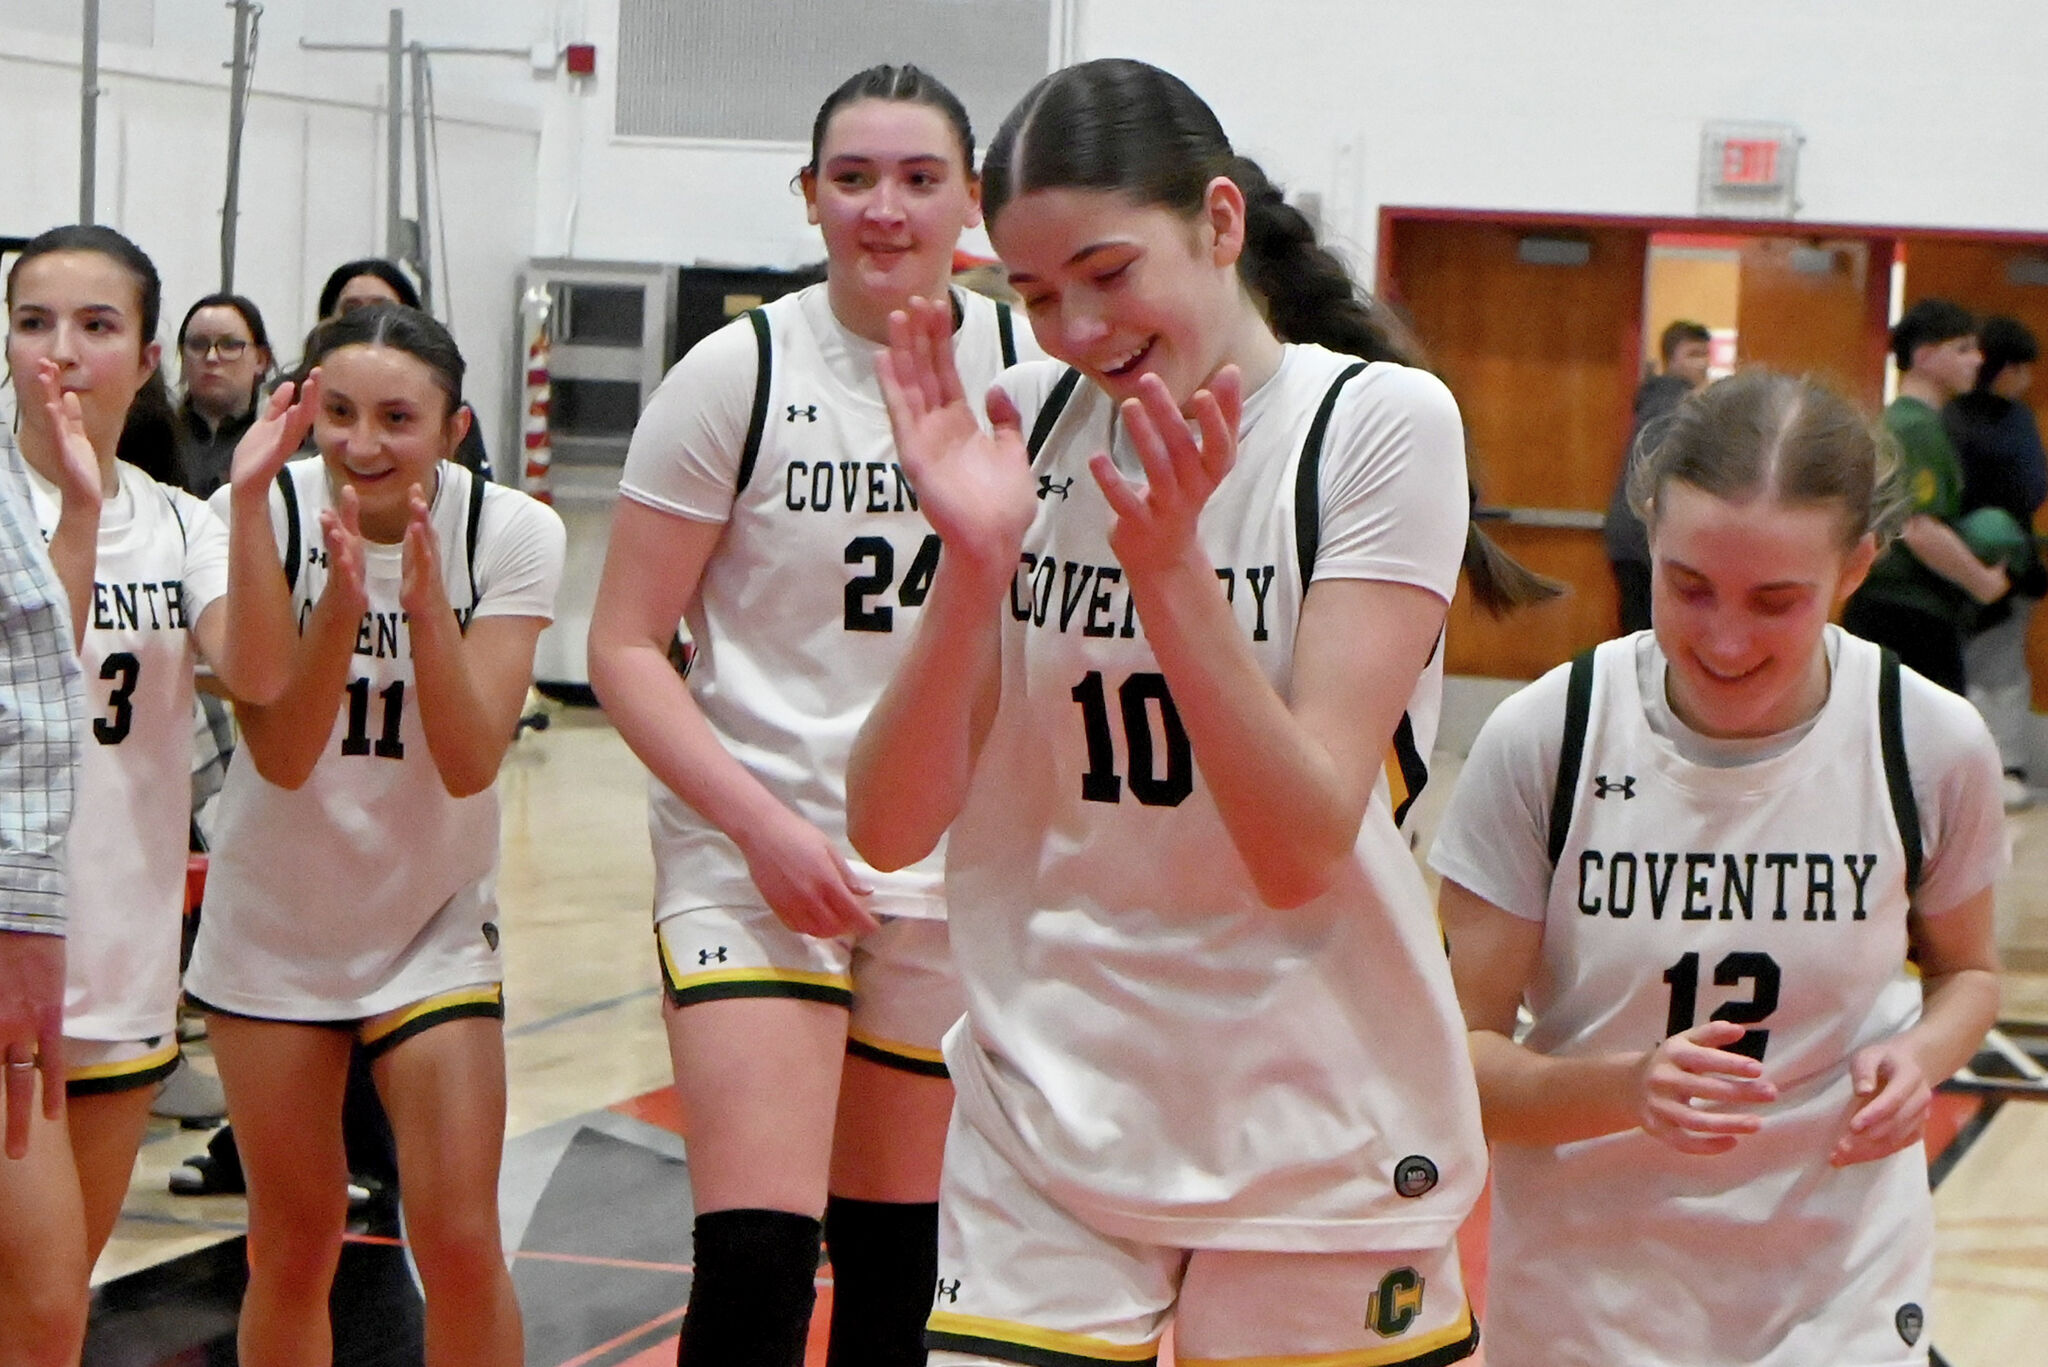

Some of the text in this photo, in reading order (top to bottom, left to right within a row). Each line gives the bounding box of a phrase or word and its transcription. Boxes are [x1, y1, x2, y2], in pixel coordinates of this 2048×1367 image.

[844, 534, 942, 632] 24
[93, 653, 140, 745] 3
[341, 677, 405, 760] 11
[1071, 671, 1193, 807] 10
[1578, 850, 1877, 921] COVENTRY
[1663, 952, 1781, 1062] 12
